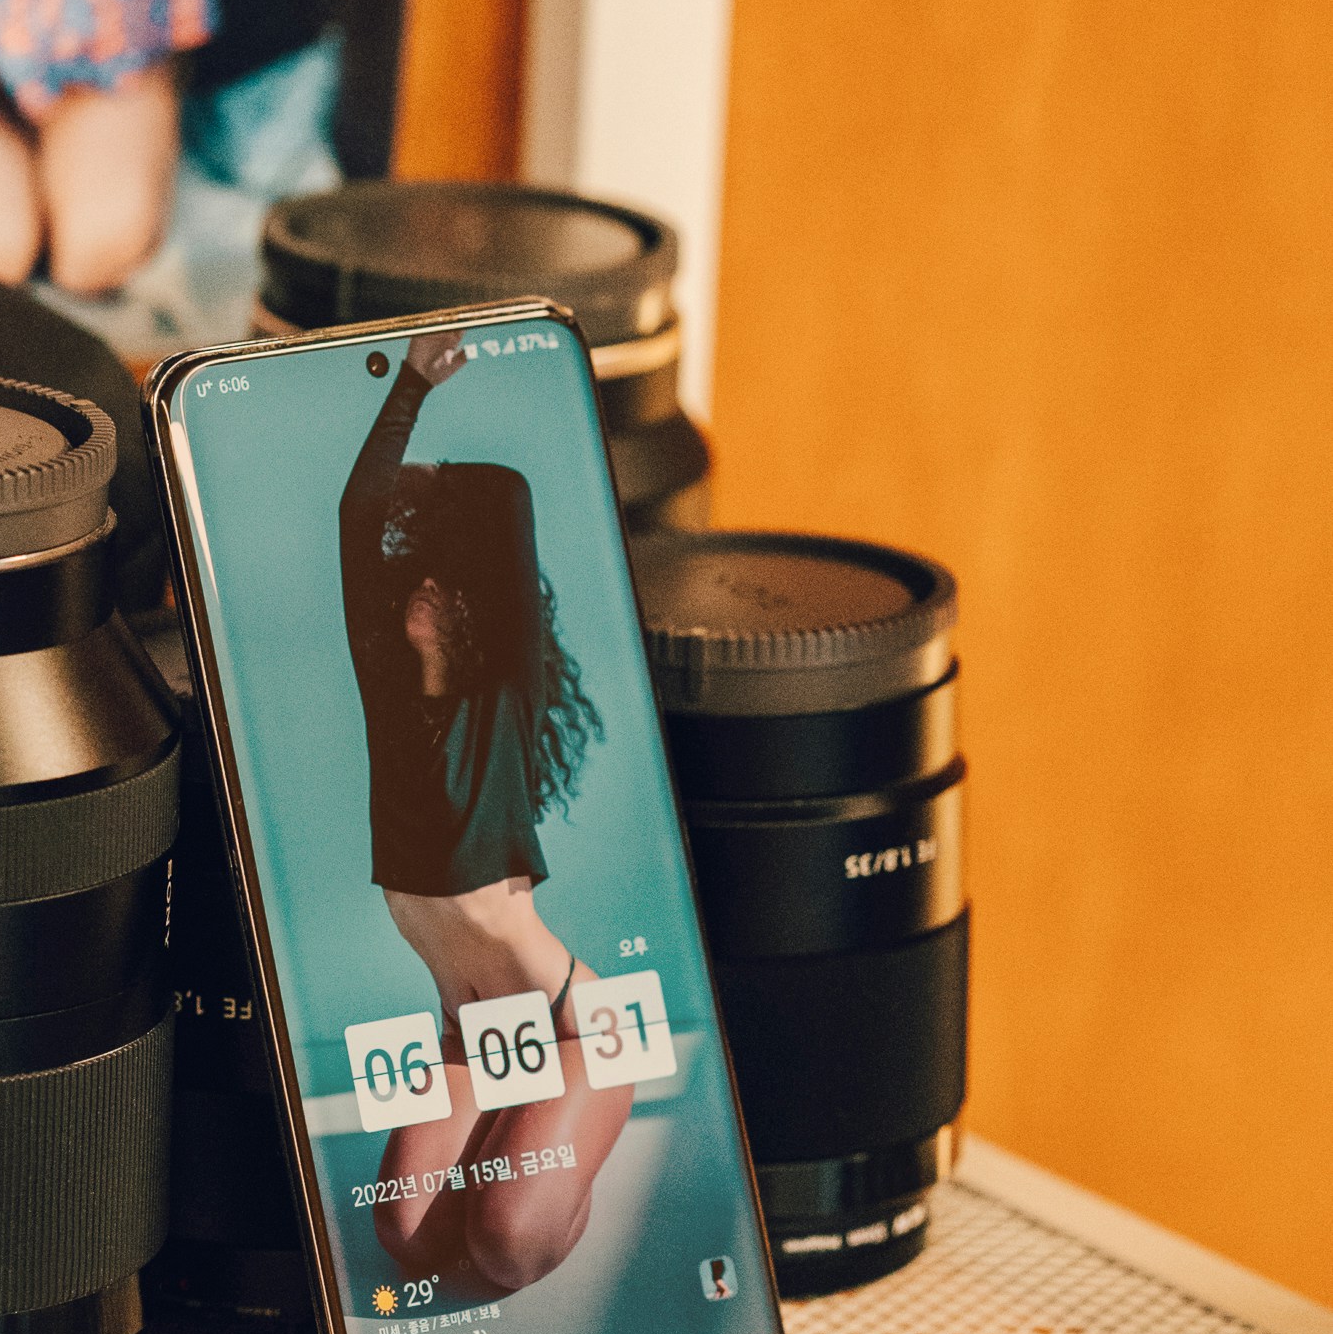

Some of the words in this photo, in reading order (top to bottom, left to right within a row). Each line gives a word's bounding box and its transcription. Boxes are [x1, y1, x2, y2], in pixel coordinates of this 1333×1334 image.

[219, 375, 250, 395] 6:06
[618, 936, 649, 958] 오후
[223, 997, 253, 1020] FE
[363, 1040, 434, 1103] 06
[478, 1020, 547, 1081] 06
[589, 1001, 652, 1061] 31
[351, 1174, 419, 1207] 2022년
[422, 1164, 466, 1193] 07월
[469, 1155, 517, 1184] 15일,
[520, 1144, 577, 1176] 금요일
[403, 1275, 439, 1308] 29°
[408, 1318, 430, 1334] 좋음
[439, 1308, 472, 1327] 초미세
[479, 1304, 501, 1320] 보통
